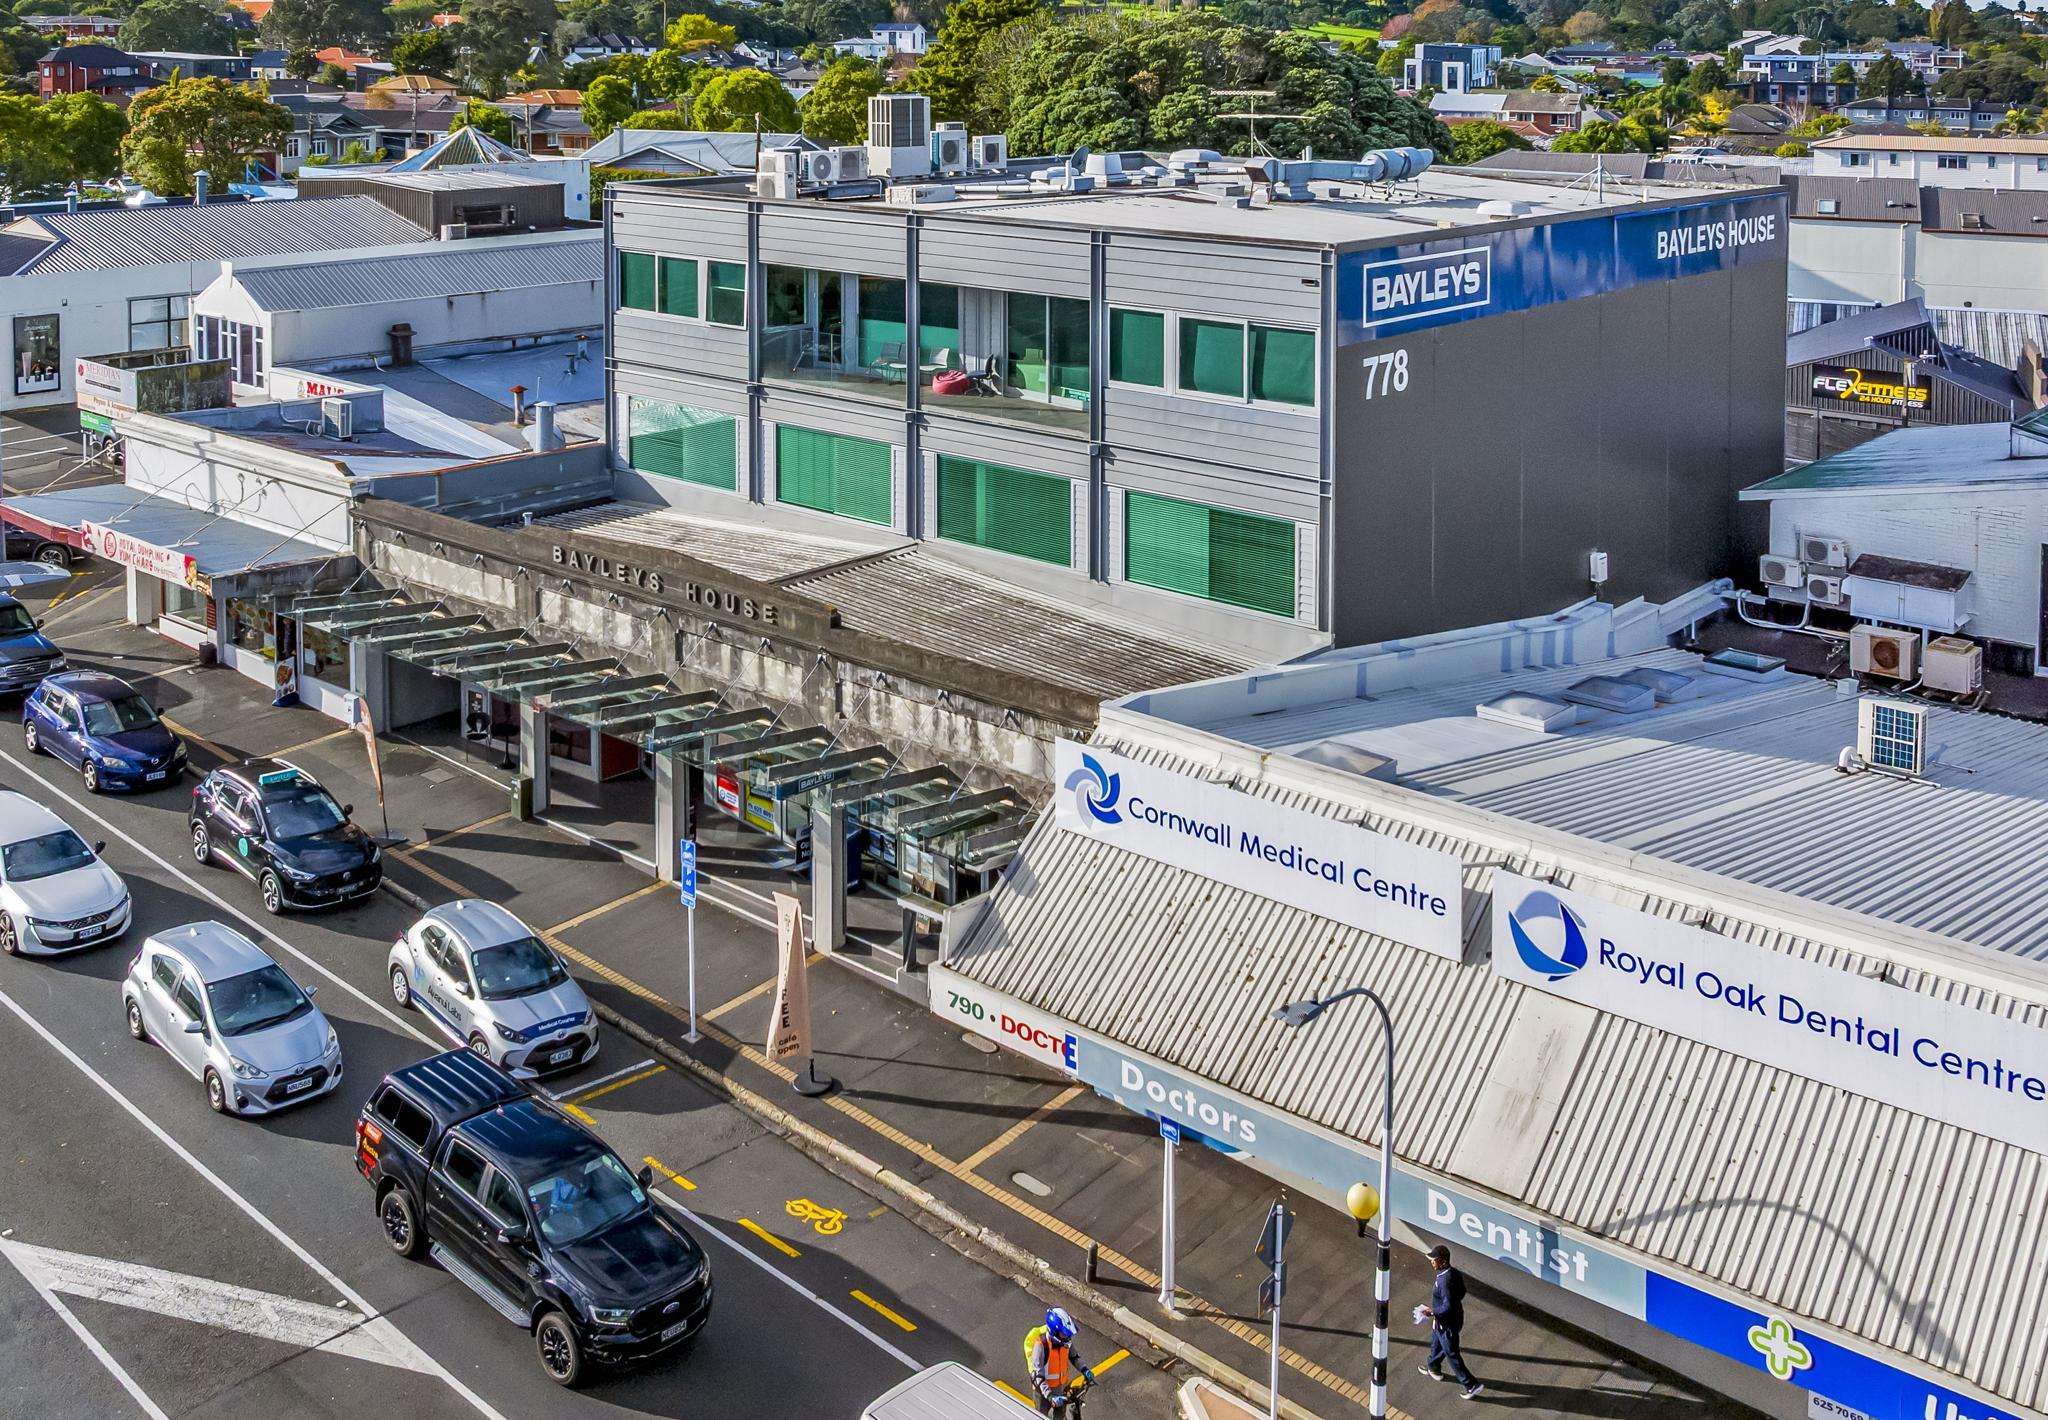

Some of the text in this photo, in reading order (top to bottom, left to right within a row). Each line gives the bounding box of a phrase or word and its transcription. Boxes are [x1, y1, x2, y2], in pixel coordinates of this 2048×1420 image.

[1657, 214, 1776, 260] BAYLEYS HOUSE
[1372, 261, 1480, 312] BAYLEYS
[1363, 349, 1409, 400] 778
[1892, 399, 1924, 408] FITESS
[552, 546, 778, 625] BAYLEYS HOUSE
[1128, 797, 1447, 917] Cornwall Medical Centre
[947, 990, 985, 1020] 790
[1599, 938, 2047, 1102] Royal Oak Dental Centre
[1121, 1059, 1257, 1143] Doctors
[1428, 1188, 1589, 1282] Dentist
[1813, 1396, 1834, 1412] 625
